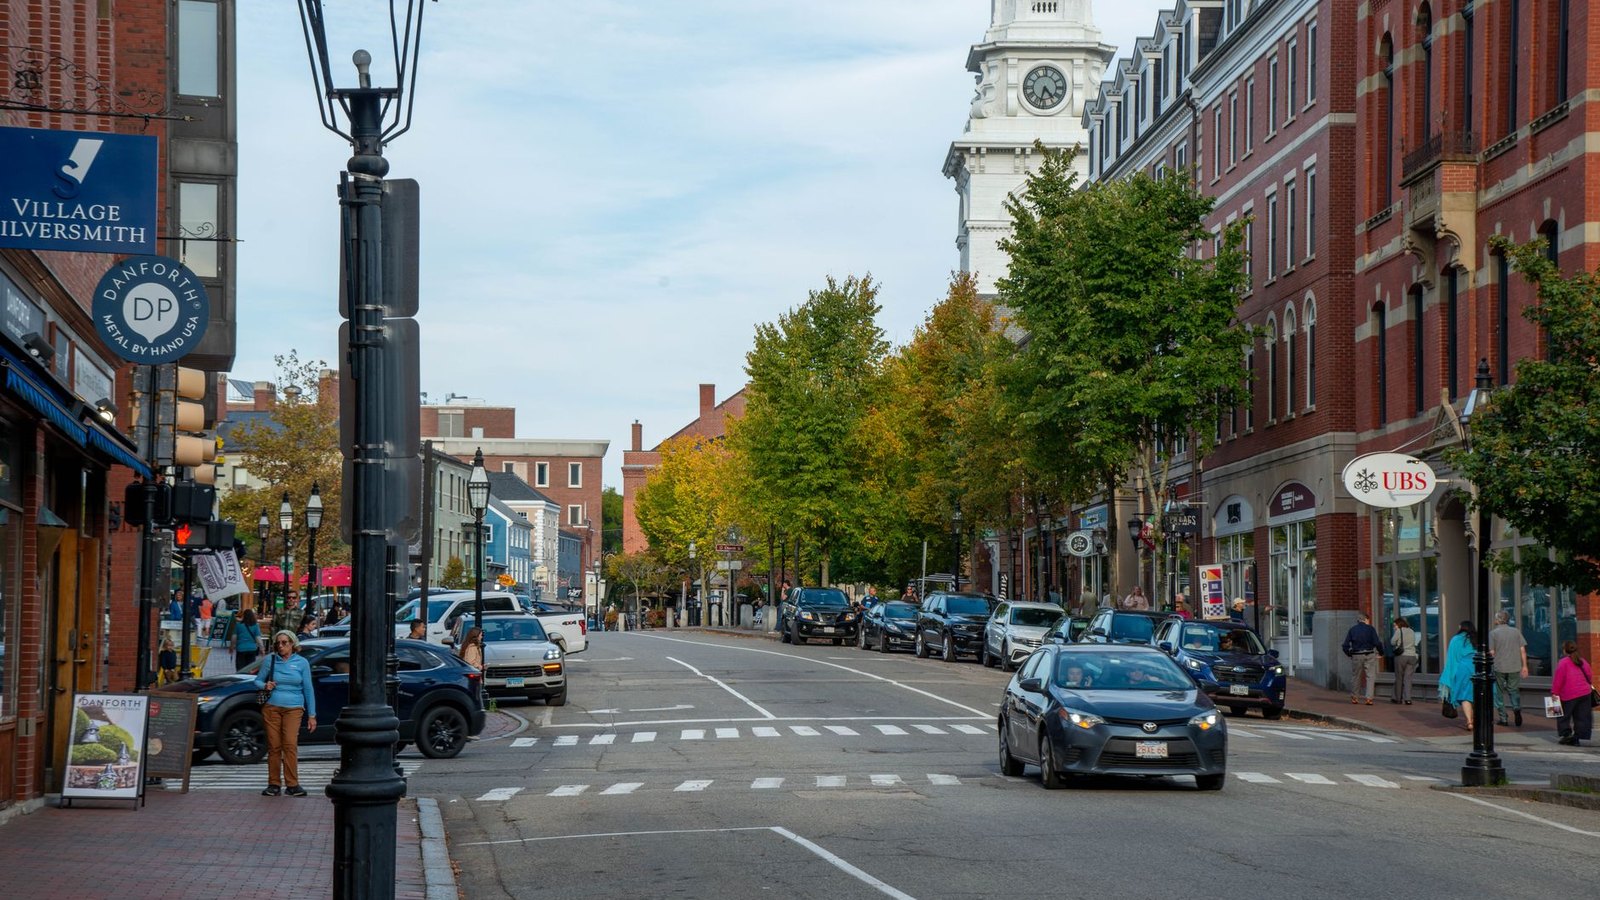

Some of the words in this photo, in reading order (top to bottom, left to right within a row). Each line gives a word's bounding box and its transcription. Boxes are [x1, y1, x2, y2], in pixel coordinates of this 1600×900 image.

[12, 198, 120, 221] VILLAGE
[0, 221, 146, 243] ILVERSMITH
[134, 297, 172, 321] DP
[103, 314, 129, 349] METAL
[131, 344, 148, 355] BY
[151, 337, 184, 356] HAND
[182, 315, 199, 337] USA
[1382, 471, 1427, 490] UBS
[1201, 571, 1210, 615] OPEN
[81, 698, 142, 708] DANFORTH
